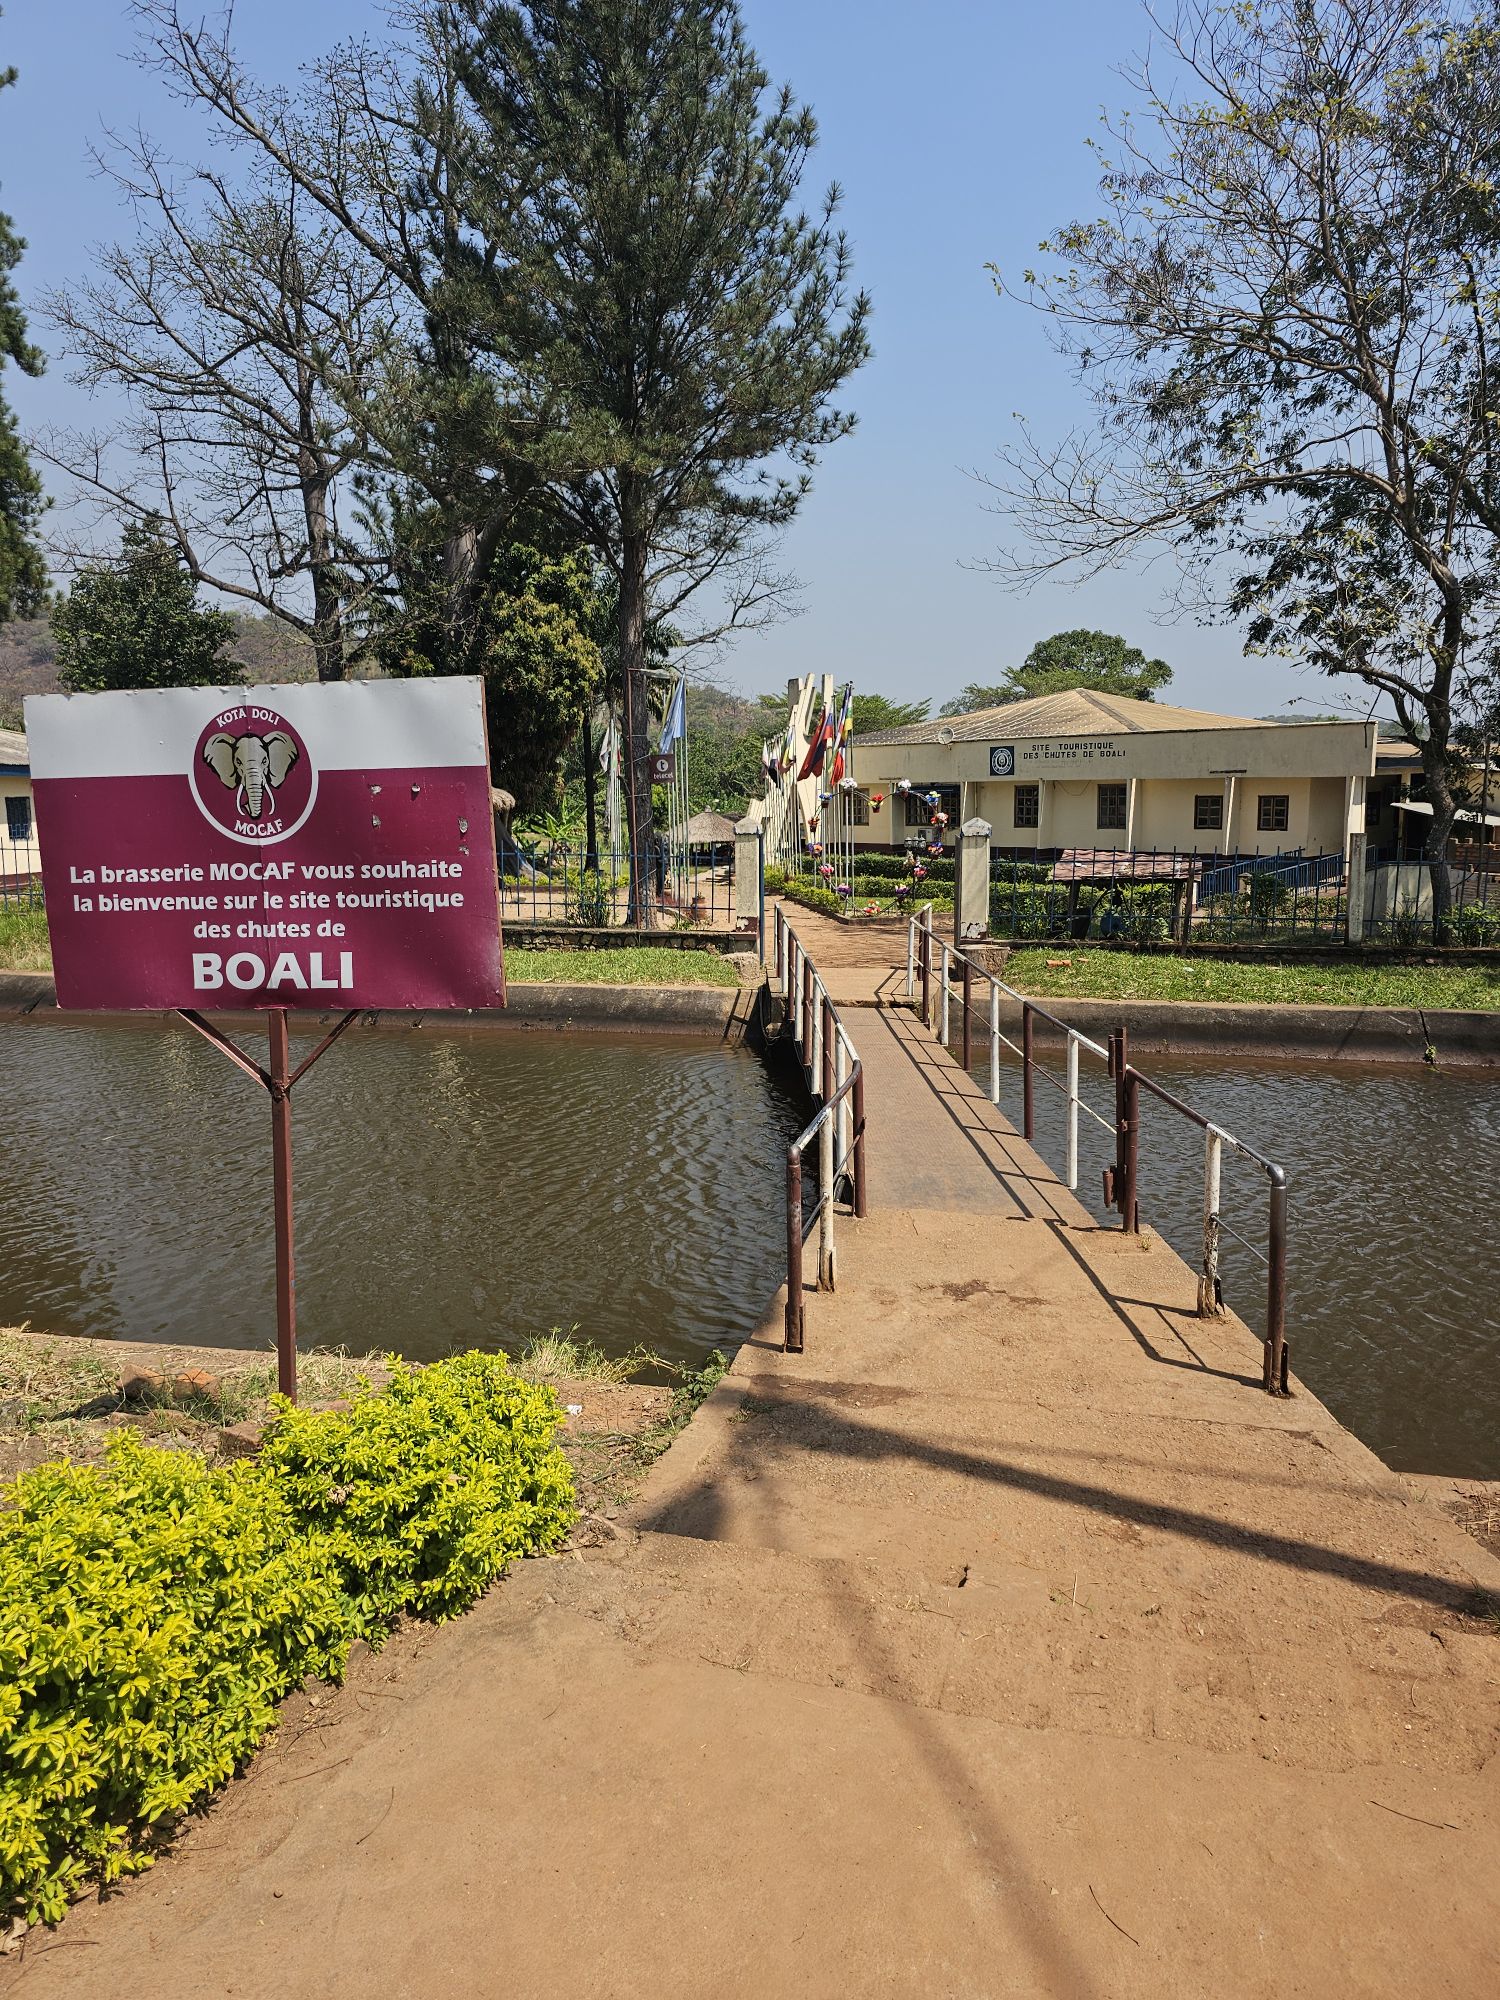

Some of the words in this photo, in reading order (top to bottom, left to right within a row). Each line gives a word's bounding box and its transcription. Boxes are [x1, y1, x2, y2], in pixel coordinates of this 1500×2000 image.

[216, 708, 247, 728] KOTA
[252, 708, 280, 726] DOLI
[1044, 751, 1077, 759] CHUTES
[1083, 750, 1094, 758] DE
[1058, 742, 1114, 750] TOURISTIQUE
[233, 818, 283, 836] MOCAF
[69, 866, 96, 884] La
[100, 864, 204, 883] brasserie
[209, 862, 296, 881] MOCAF
[300, 864, 355, 880] vous
[360, 860, 463, 879] souhaite
[73, 891, 93, 912] la
[98, 890, 218, 912] bienvenue
[223, 894, 258, 910] sur
[263, 891, 284, 910] le
[289, 890, 331, 909] site
[336, 888, 465, 913] touristique
[193, 920, 231, 939] des
[236, 920, 311, 939] chutes
[316, 919, 346, 937] de
[192, 951, 354, 990] BOALI
